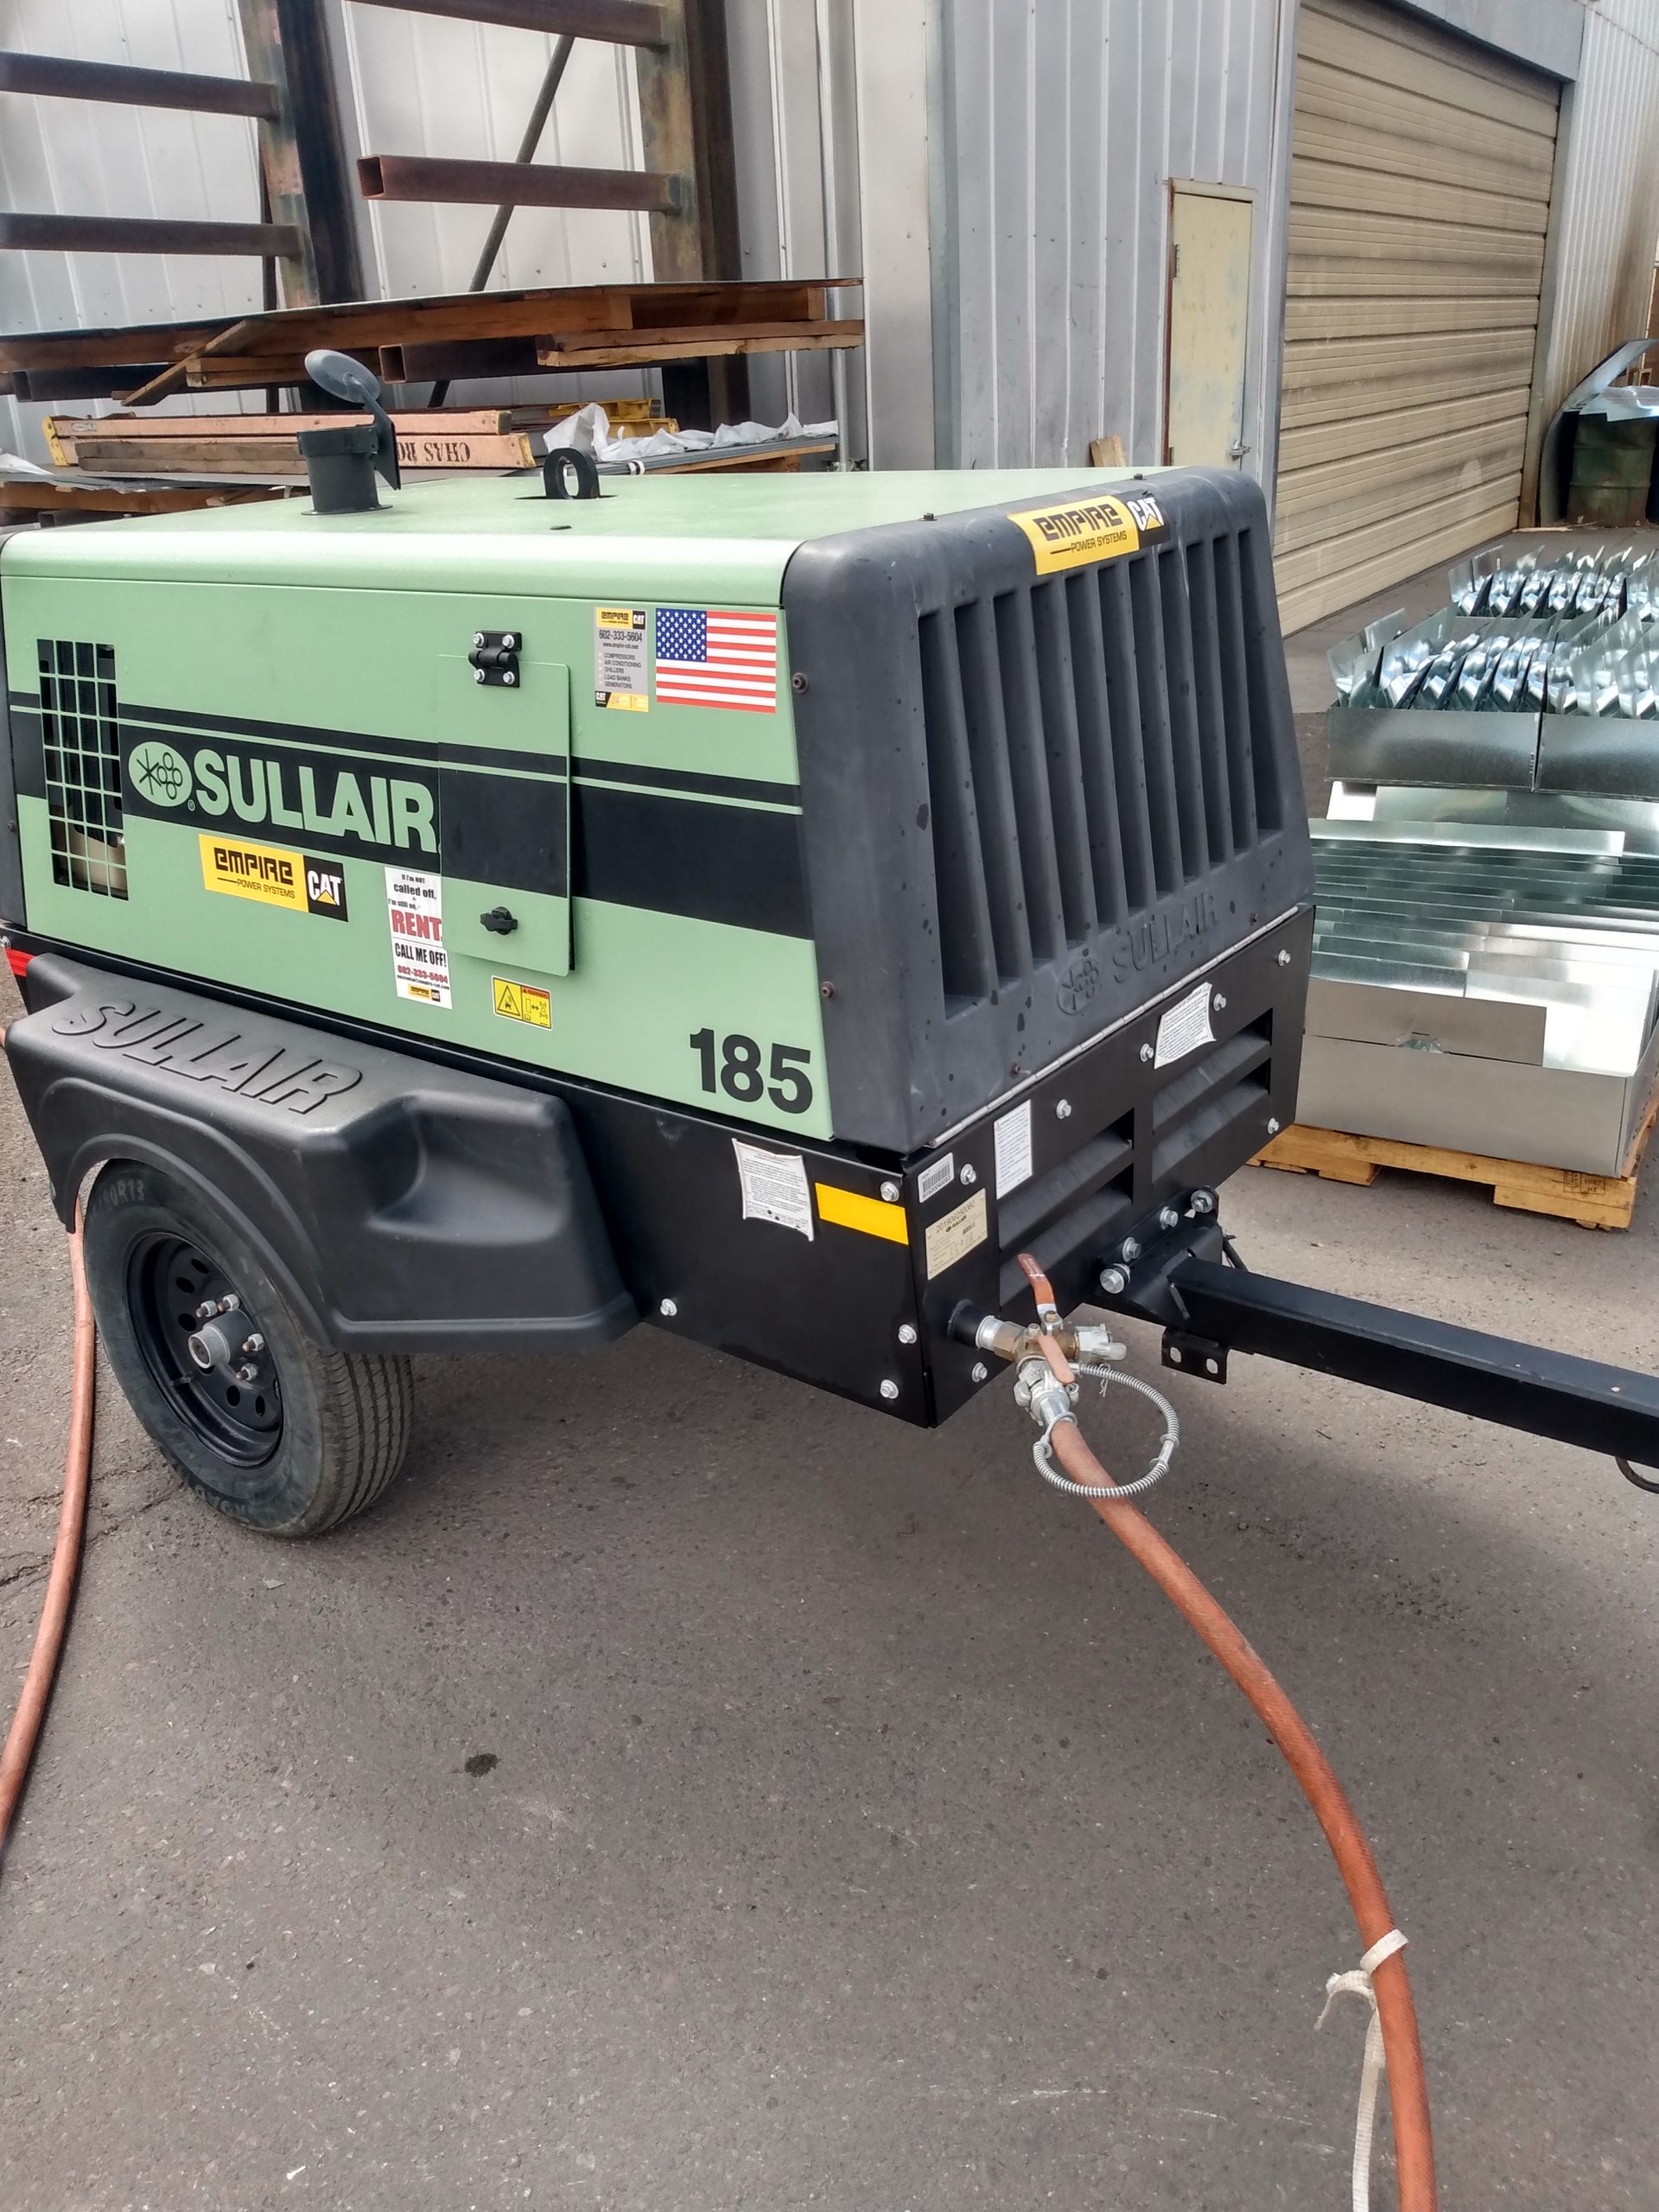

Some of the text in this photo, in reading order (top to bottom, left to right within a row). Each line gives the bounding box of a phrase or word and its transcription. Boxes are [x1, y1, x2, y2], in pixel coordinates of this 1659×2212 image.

[423, 442, 470, 462] CHAS
[1032, 504, 1122, 541] EMPIRE
[1126, 498, 1164, 531] CAT
[1071, 531, 1128, 553] POWER SYSTEMS
[601, 612, 629, 620] EMPIRE
[632, 614, 645, 625] CAT
[599, 629, 643, 642] 602-333-5604
[194, 748, 437, 854] SULLAIR
[213, 847, 294, 886] EMPIRE
[237, 878, 296, 899] POWER SYSTEMS
[307, 870, 342, 906] CAT
[393, 884, 421, 896] called
[1112, 892, 1218, 984] SULLAIR
[395, 943, 448, 968] CALL ME OFF!
[52, 1000, 363, 1115] SULLAIR
[690, 1027, 813, 1115] 185
